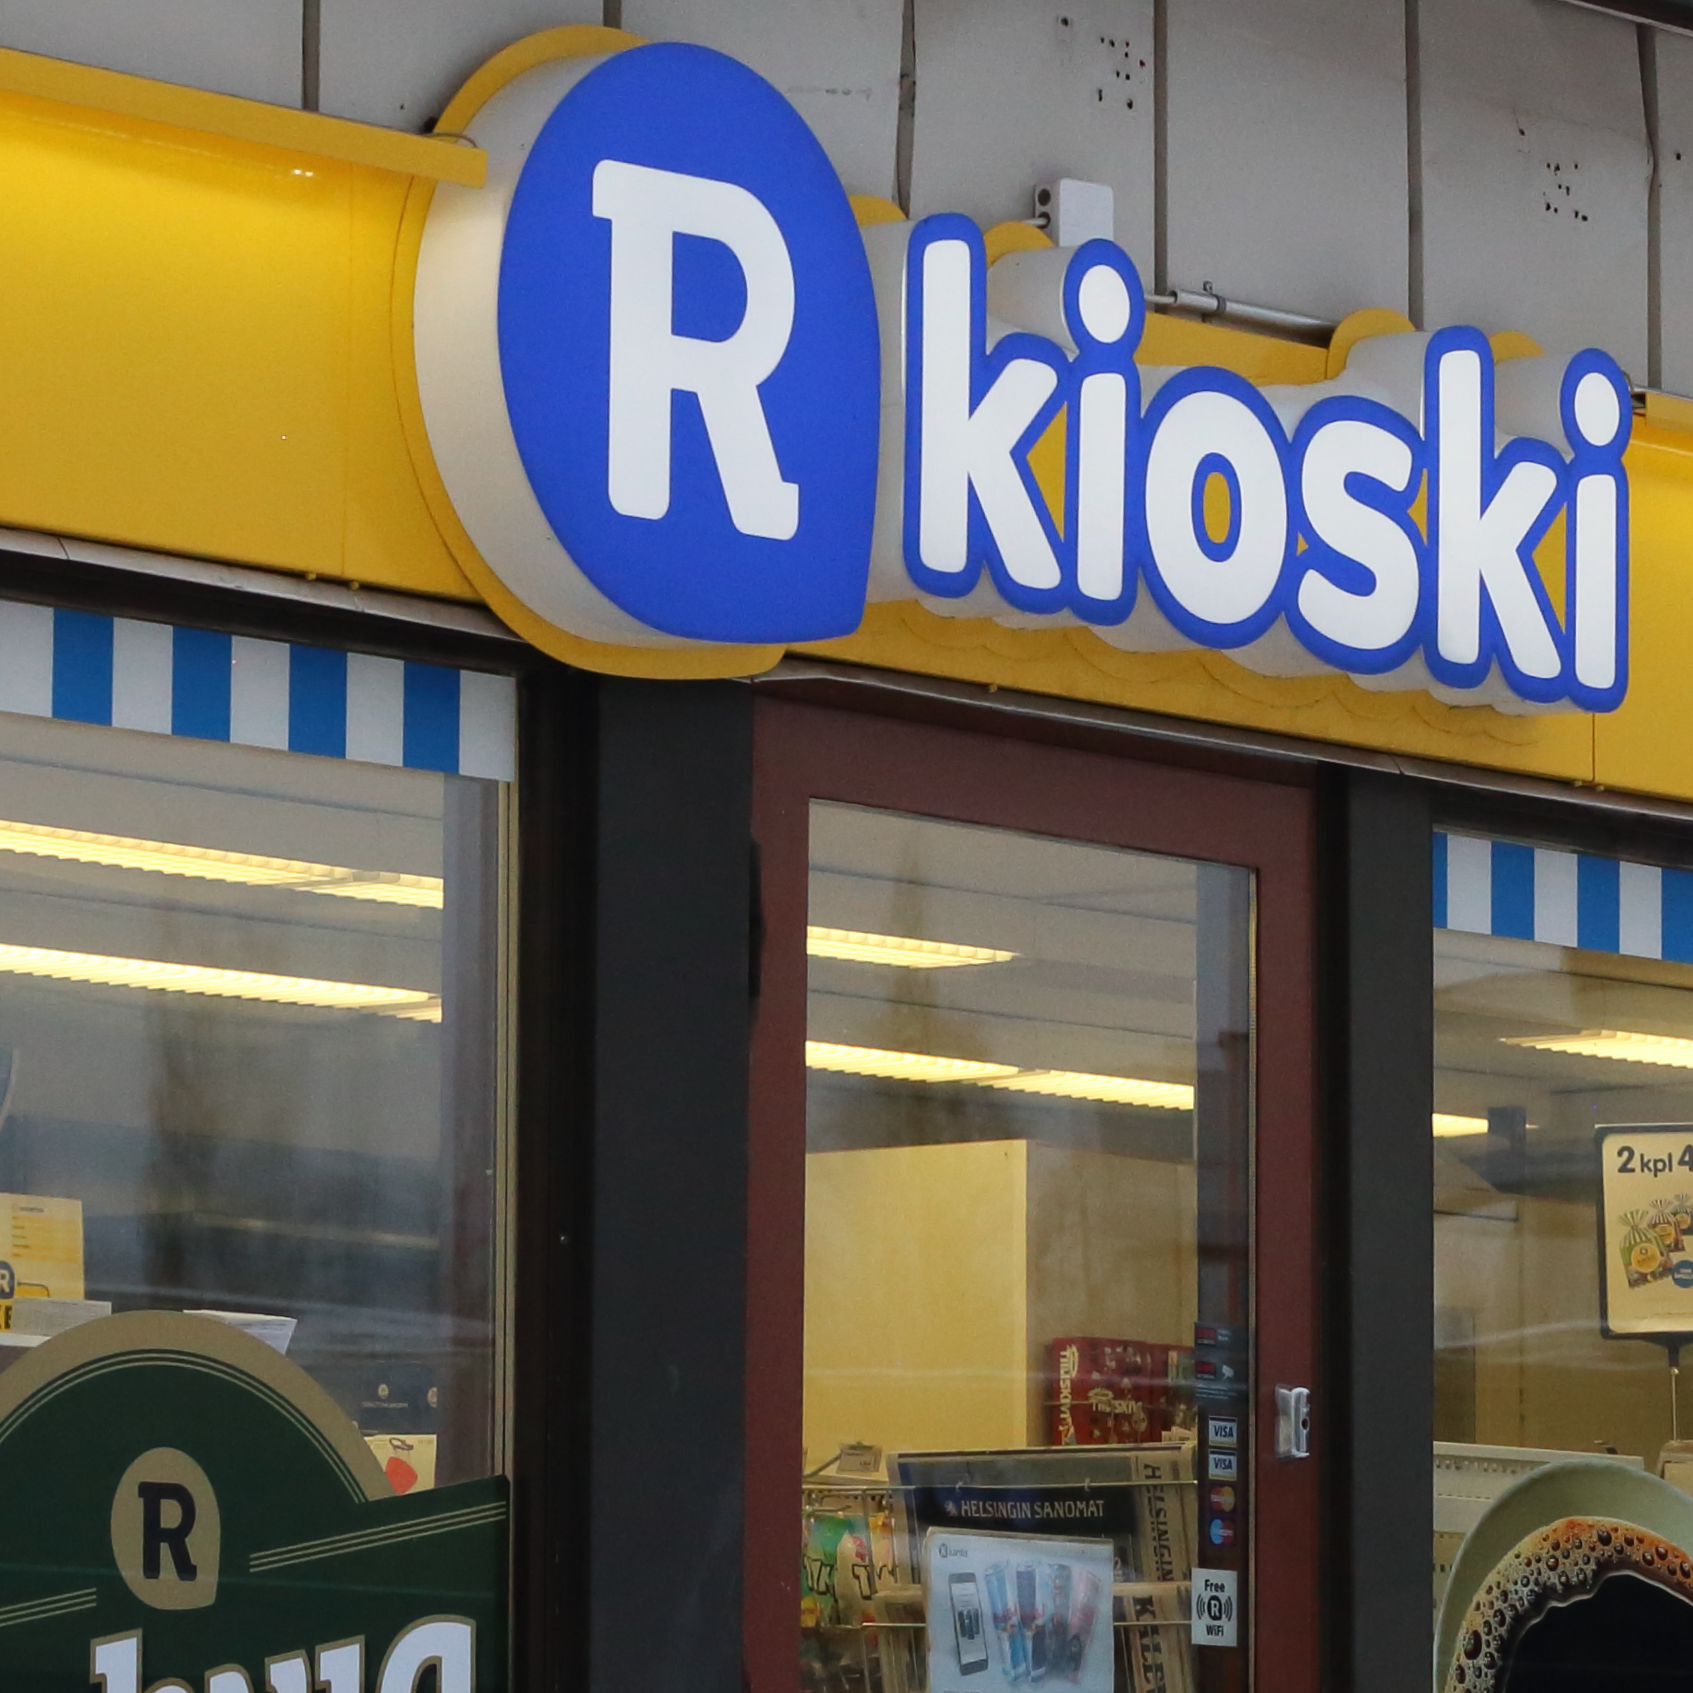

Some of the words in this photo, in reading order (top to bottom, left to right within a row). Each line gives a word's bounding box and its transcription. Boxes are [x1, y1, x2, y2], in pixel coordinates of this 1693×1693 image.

[590, 157, 800, 541] R
[918, 233, 1620, 695] kioski
[1616, 1145, 1636, 1174] 2
[1639, 1152, 1673, 1178] kpl
[1213, 1425, 1234, 1438] VISA
[1213, 1458, 1233, 1471] VISA
[961, 1500, 1032, 1519] HELSINGIN
[1034, 1499, 1105, 1519] SANOMAT
[136, 1480, 199, 1582] R
[1204, 1579, 1226, 1593] Free
[1206, 1624, 1224, 1637] WiFi
